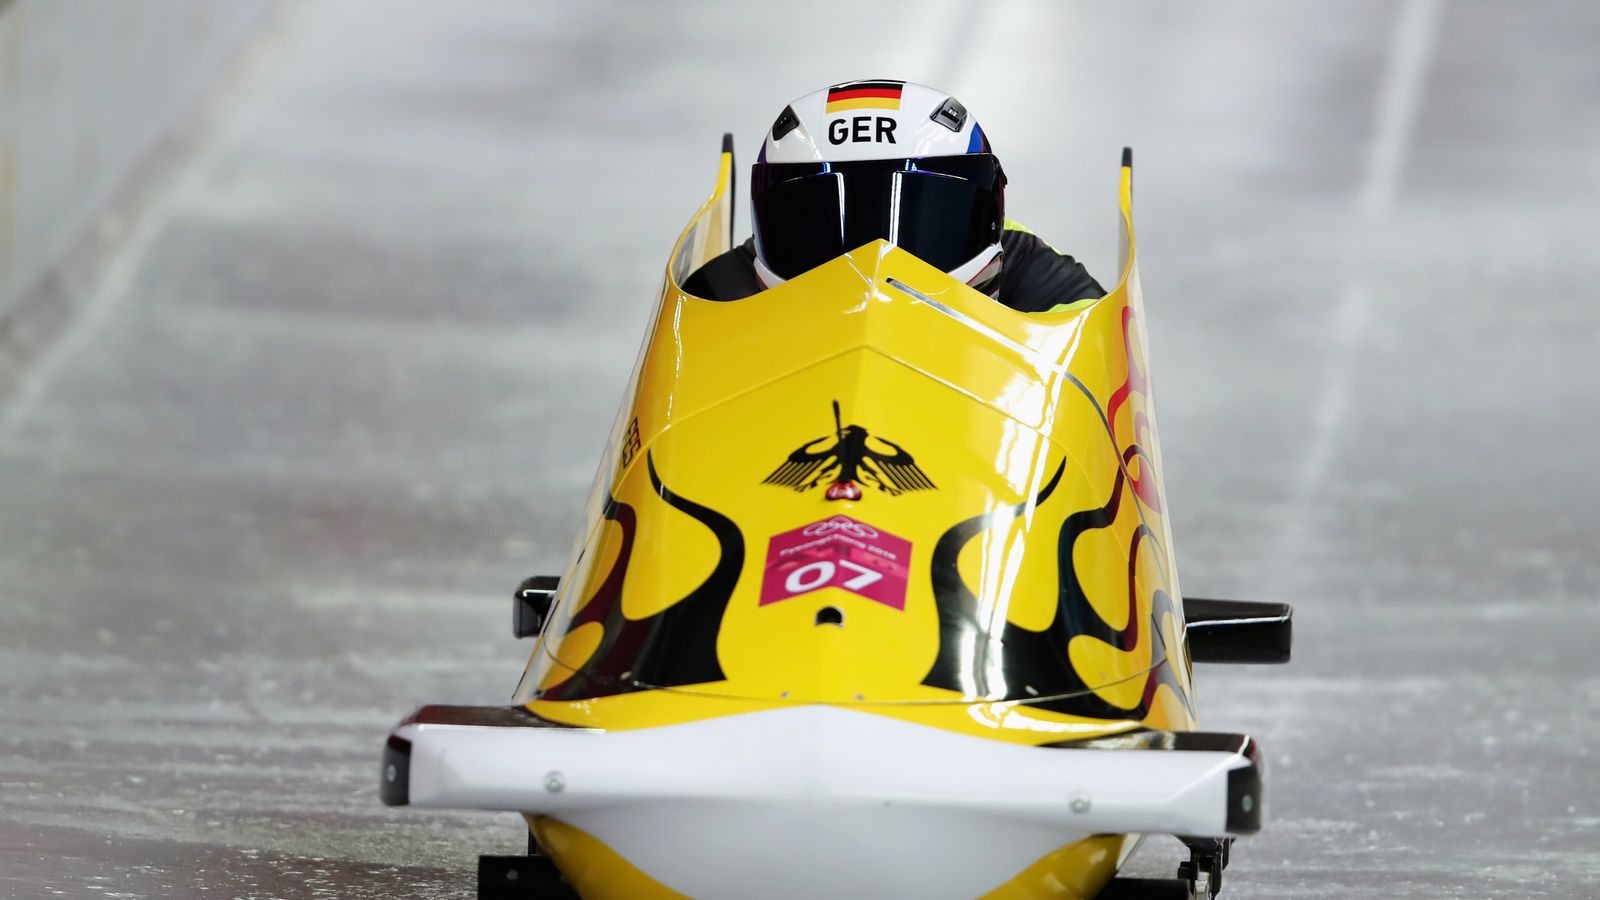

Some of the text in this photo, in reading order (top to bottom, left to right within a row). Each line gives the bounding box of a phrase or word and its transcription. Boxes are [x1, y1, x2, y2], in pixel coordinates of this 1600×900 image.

[828, 116, 897, 145] GER
[867, 545, 896, 560] 2018
[785, 560, 883, 593] 07
